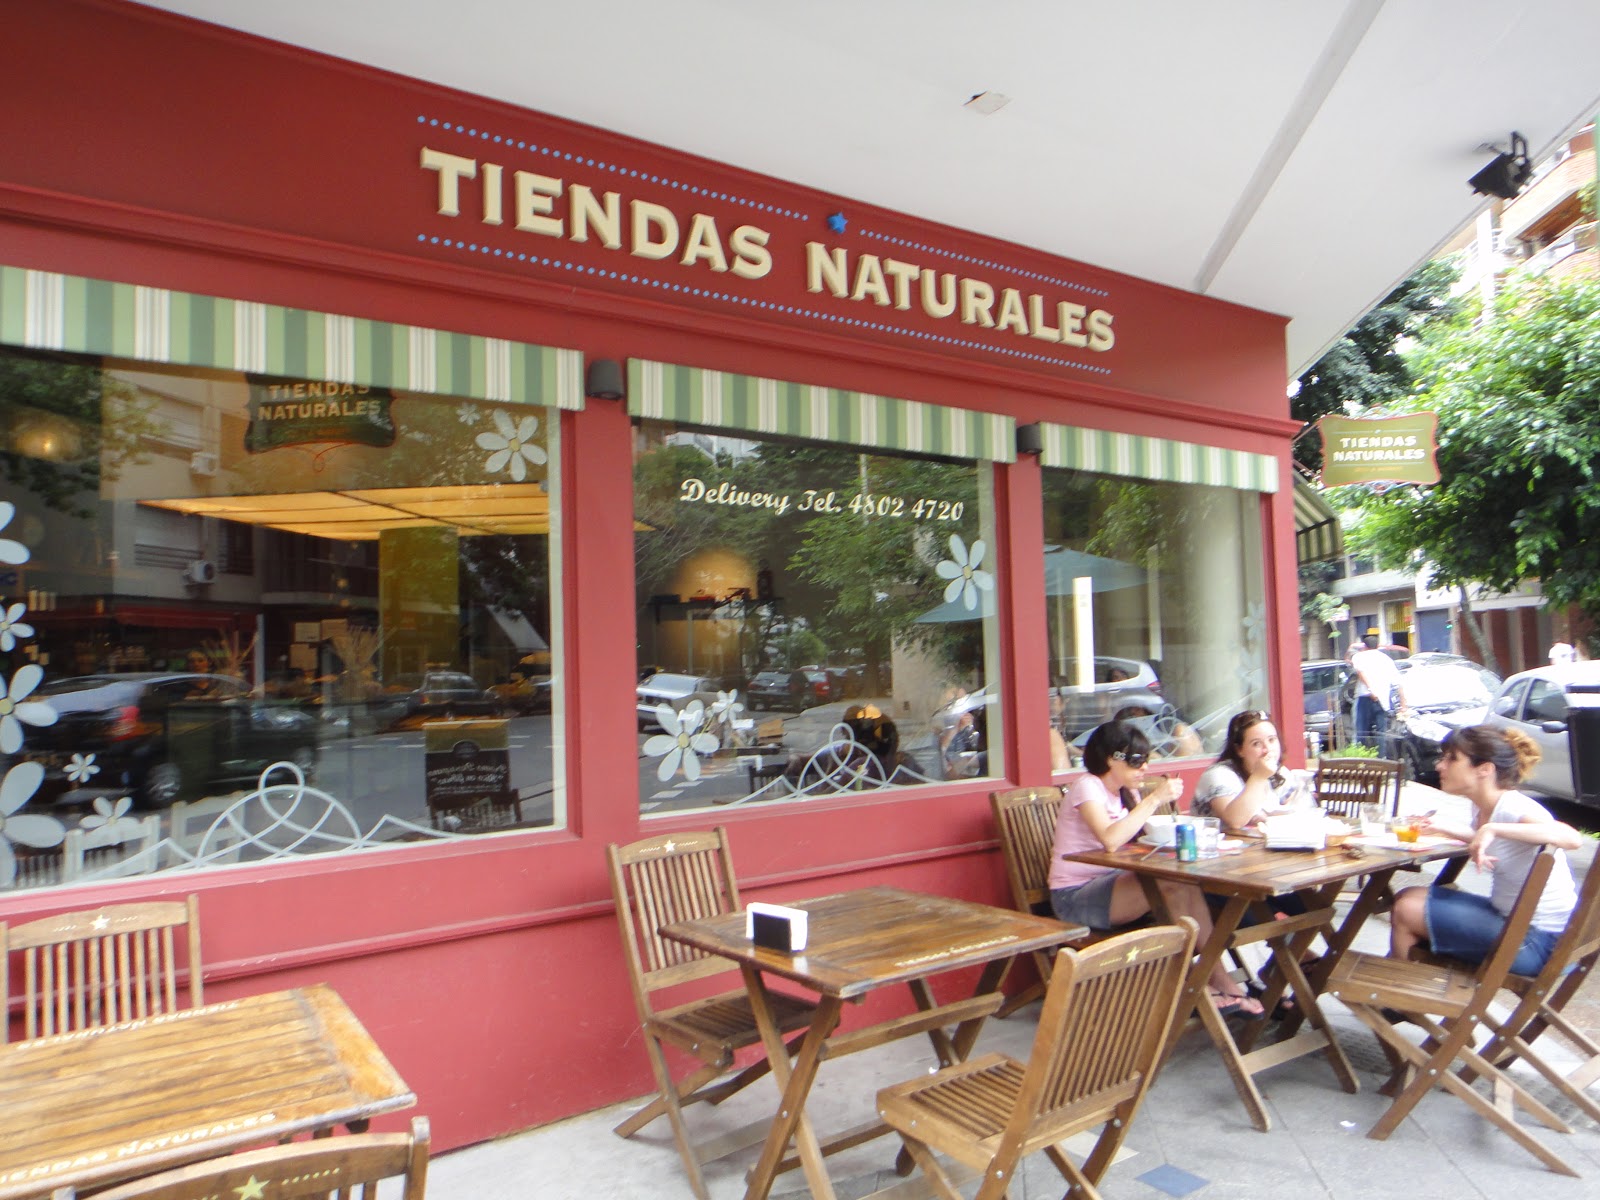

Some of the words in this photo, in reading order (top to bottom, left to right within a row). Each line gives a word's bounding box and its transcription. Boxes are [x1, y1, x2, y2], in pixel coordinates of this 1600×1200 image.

[419, 146, 774, 279] TIENDAS
[805, 240, 1116, 352] NATURALES
[257, 401, 381, 421] NATURALES
[1339, 435, 1417, 449] TIENDAS
[1332, 448, 1426, 462] NATURALES
[679, 478, 791, 516] Delivery
[797, 489, 842, 513] Tel.
[848, 493, 904, 518] 4802
[911, 498, 965, 522] 4720
